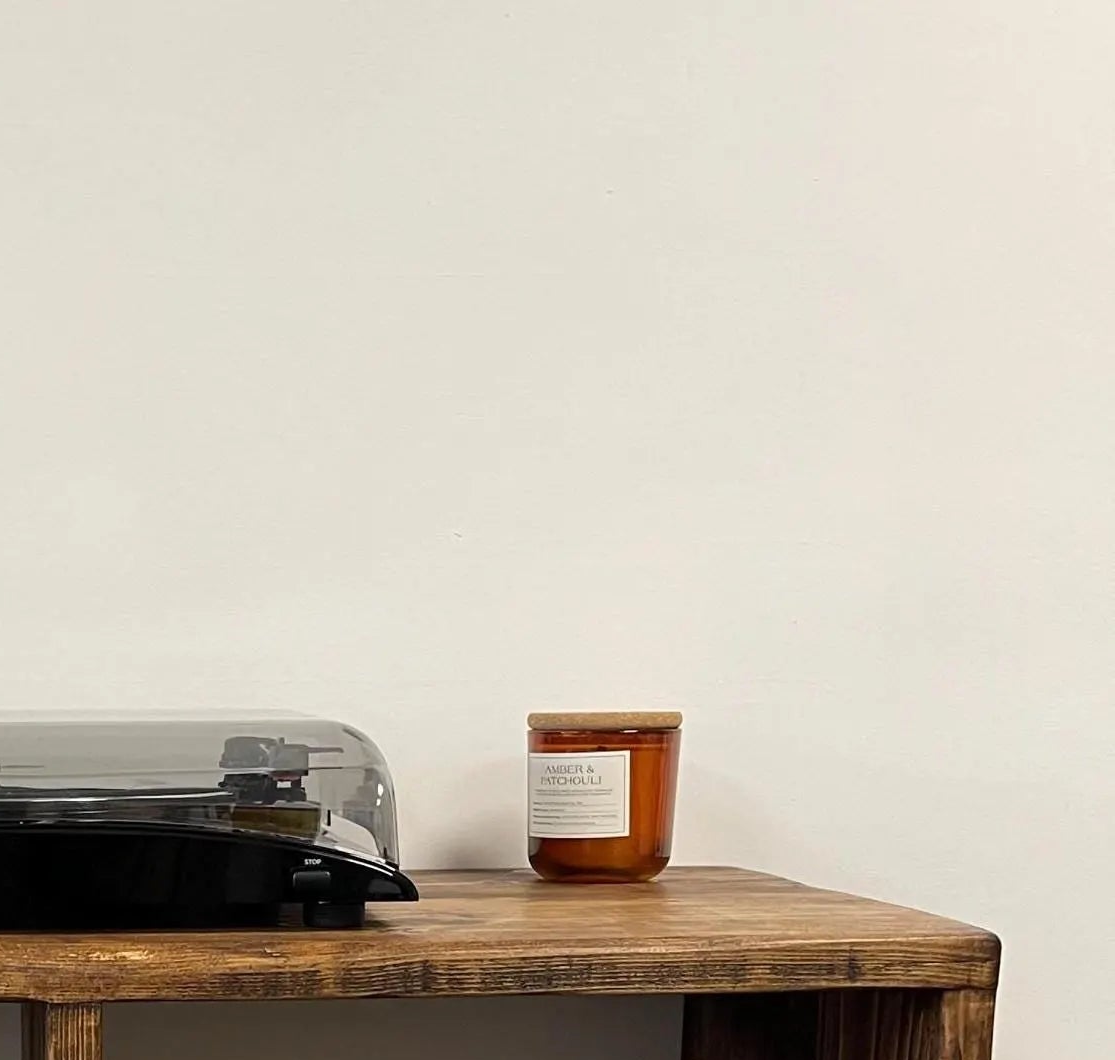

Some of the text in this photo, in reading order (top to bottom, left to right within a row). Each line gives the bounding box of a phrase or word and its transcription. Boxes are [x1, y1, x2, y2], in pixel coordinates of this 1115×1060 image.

[544, 764, 595, 774] AMBER &
[540, 776, 602, 786] PATCHOULI
[304, 858, 322, 866] STOP
